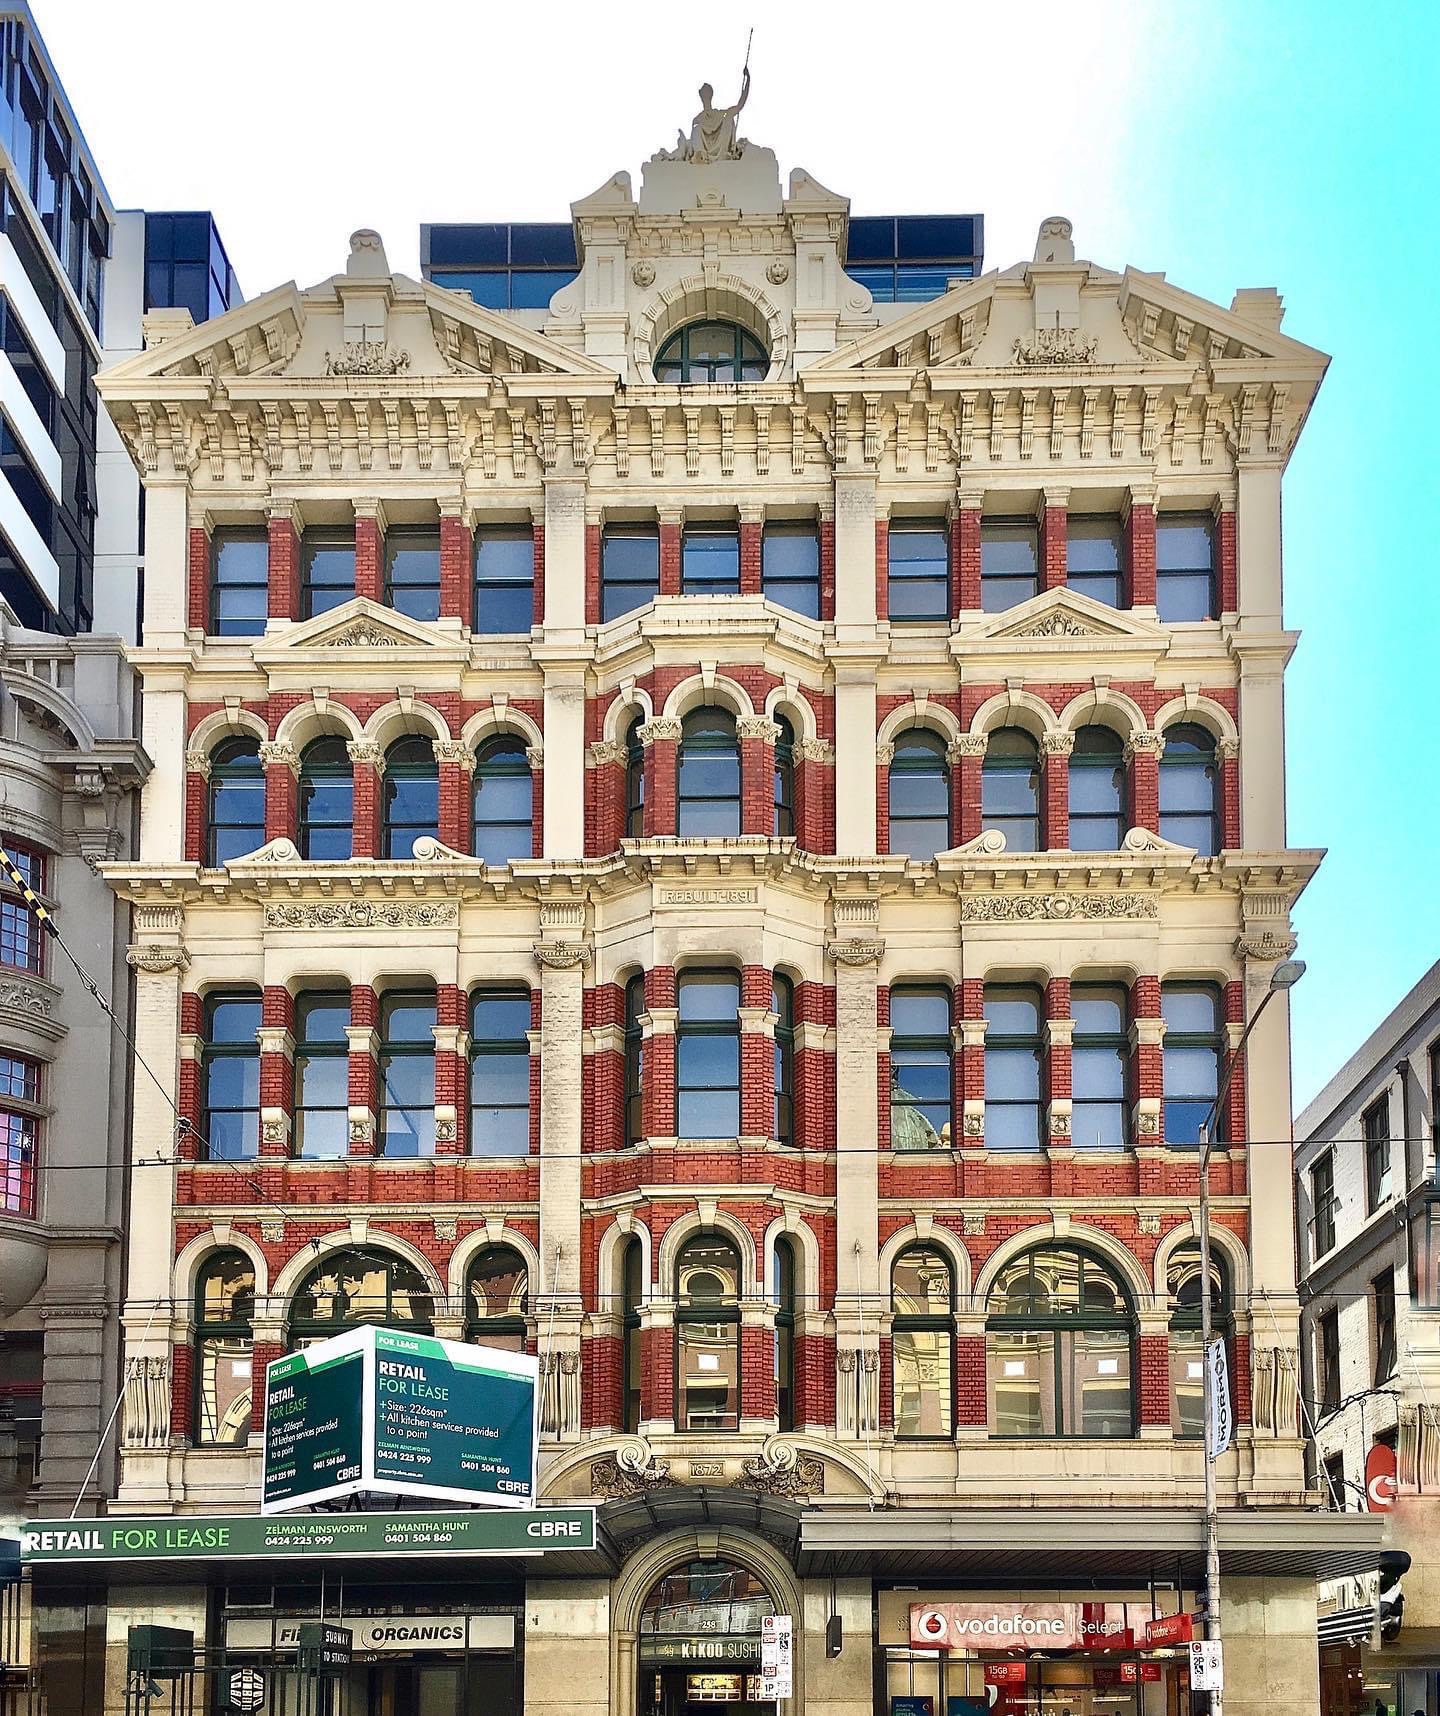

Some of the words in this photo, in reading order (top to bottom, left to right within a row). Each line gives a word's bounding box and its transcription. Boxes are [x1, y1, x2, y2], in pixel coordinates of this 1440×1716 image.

[378, 1336, 396, 1345] FOR
[397, 1340, 419, 1350] LEASE
[379, 1360, 426, 1381] RETAIL
[269, 1385, 295, 1406] RETAIL
[379, 1378, 407, 1395] FOR
[411, 1382, 449, 1401] LEASE
[268, 1405, 284, 1420] FOR
[285, 1396, 307, 1415] LEASE
[278, 1434, 296, 1445] kitchen
[296, 1428, 315, 1440] services
[315, 1418, 338, 1437] provided
[387, 1425, 396, 1436] to
[406, 1429, 428, 1439] point
[401, 1414, 430, 1428] kitchen
[432, 1421, 463, 1433] services
[465, 1426, 499, 1438] provided
[271, 1450, 277, 1459] to
[281, 1445, 294, 1458] point
[378, 1450, 398, 1460] 0424
[399, 1453, 415, 1462] 225
[417, 1455, 432, 1464] 999
[336, 1465, 361, 1481] CBRE
[461, 1461, 479, 1470] 0401
[481, 1464, 495, 1473] 504
[496, 1466, 510, 1475] 860
[690, 1463, 721, 1476] 1872
[496, 1479, 530, 1494] CBRE
[265, 1524, 306, 1535] ZELMAN
[308, 1523, 368, 1534] AINSWORTH
[385, 1522, 441, 1534] SAMANTHA
[443, 1522, 470, 1532] HUNT
[526, 1520, 582, 1537] CBRE
[26, 1531, 104, 1551] RETAIL
[112, 1530, 158, 1549] FOR
[166, 1528, 230, 1548] LEASE
[265, 1536, 291, 1546] 0424
[292, 1536, 313, 1546] 225
[314, 1535, 334, 1545] 999
[384, 1533, 410, 1543] 0401
[411, 1533, 432, 1543] 504
[433, 1532, 452, 1542] 860
[954, 1613, 1065, 1635] vodafone
[1077, 1619, 1124, 1634] Select
[325, 1630, 350, 1646] SUBWAY
[371, 1626, 464, 1640] ORGANICS
[778, 1632, 790, 1640] 2P
[323, 1651, 330, 1662] TO
[727, 1643, 760, 1658] SUSHI
[1193, 1656, 1204, 1666] 2P
[988, 1666, 1008, 1674] 15GB
[764, 1684, 774, 1692] 1P
